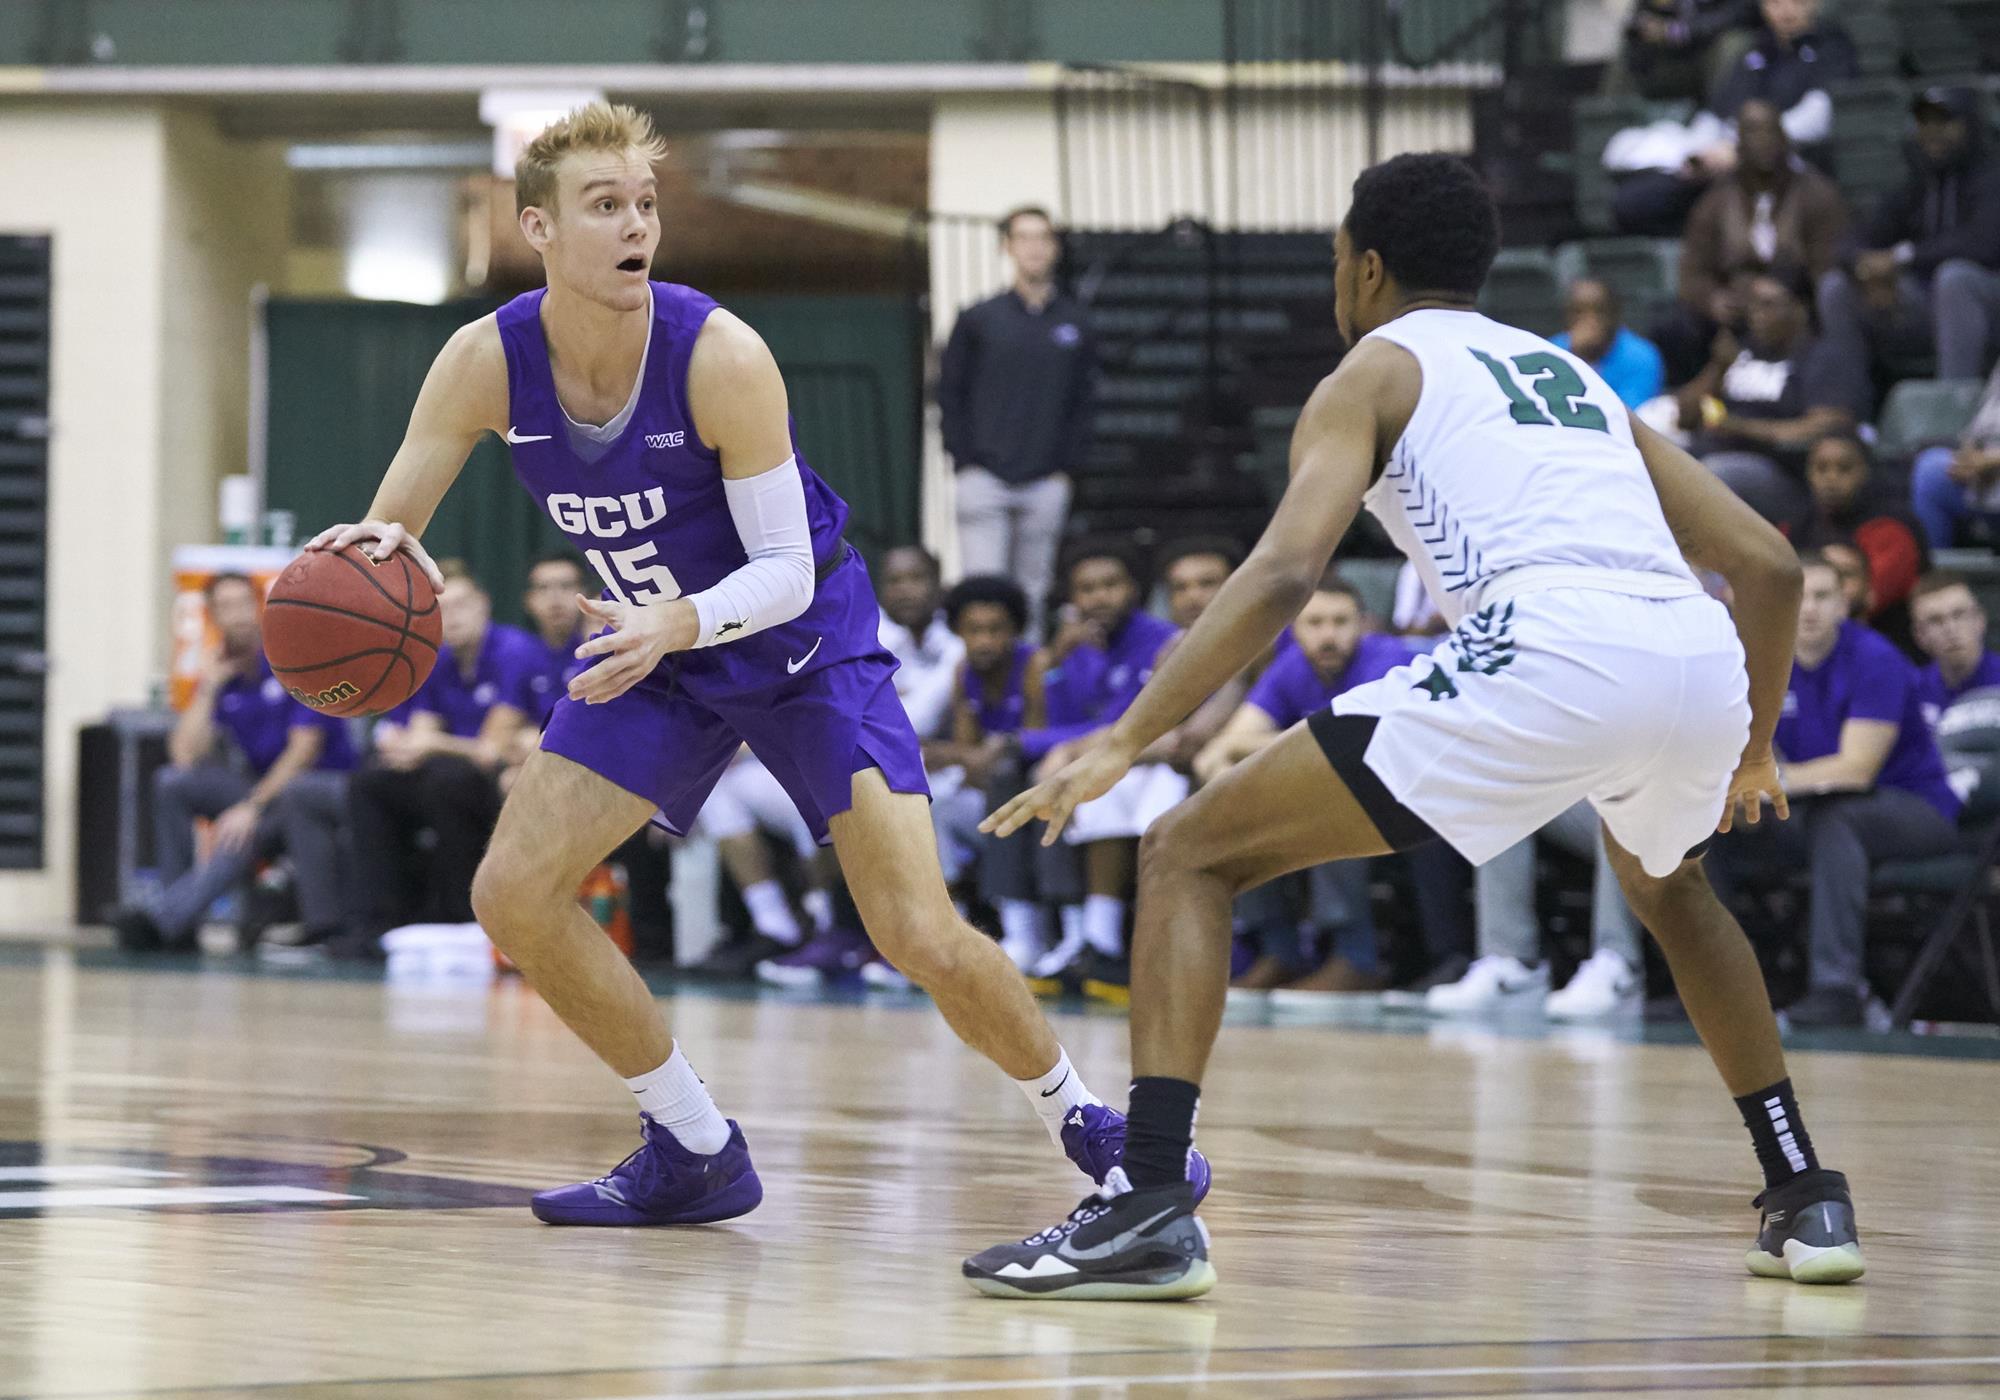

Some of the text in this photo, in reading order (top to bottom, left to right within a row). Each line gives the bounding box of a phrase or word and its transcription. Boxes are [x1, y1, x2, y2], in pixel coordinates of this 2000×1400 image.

[1466, 346, 1612, 434] 12
[645, 430, 684, 448] WAC
[547, 486, 667, 538] GCU
[585, 541, 682, 606] 15
